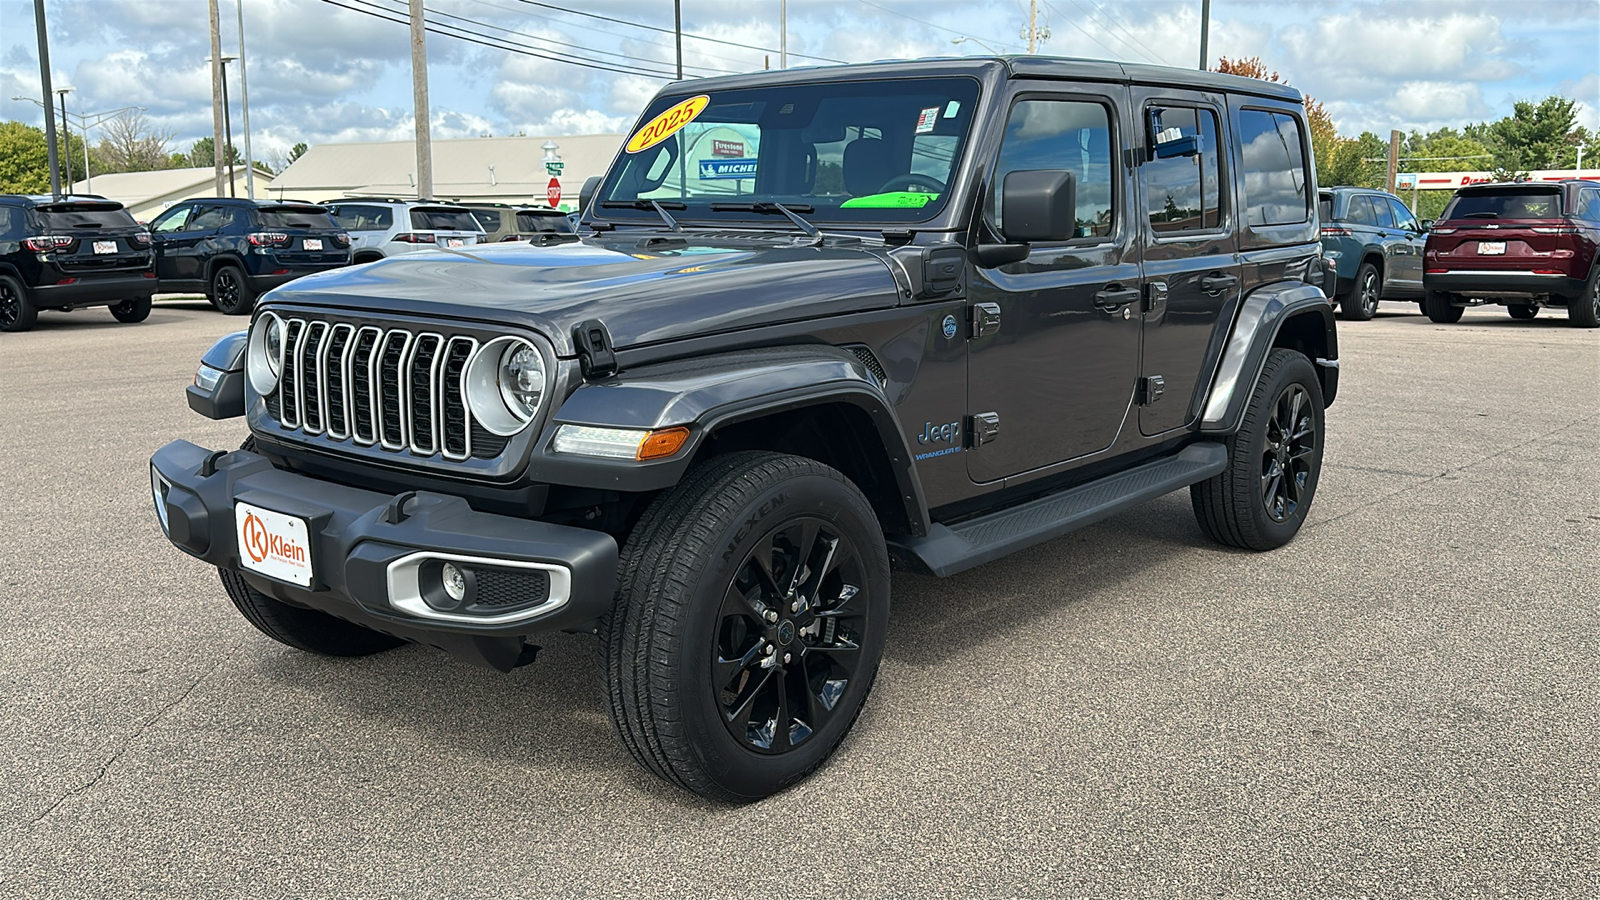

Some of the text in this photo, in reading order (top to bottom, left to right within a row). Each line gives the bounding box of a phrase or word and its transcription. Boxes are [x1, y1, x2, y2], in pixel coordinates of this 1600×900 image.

[640, 100, 696, 148] 2025
[548, 186, 560, 199] STOP
[918, 421, 960, 446] Jeep
[915, 448, 954, 461] WRANGLER
[721, 492, 788, 564] NEXEN
[269, 532, 305, 563] Klein
